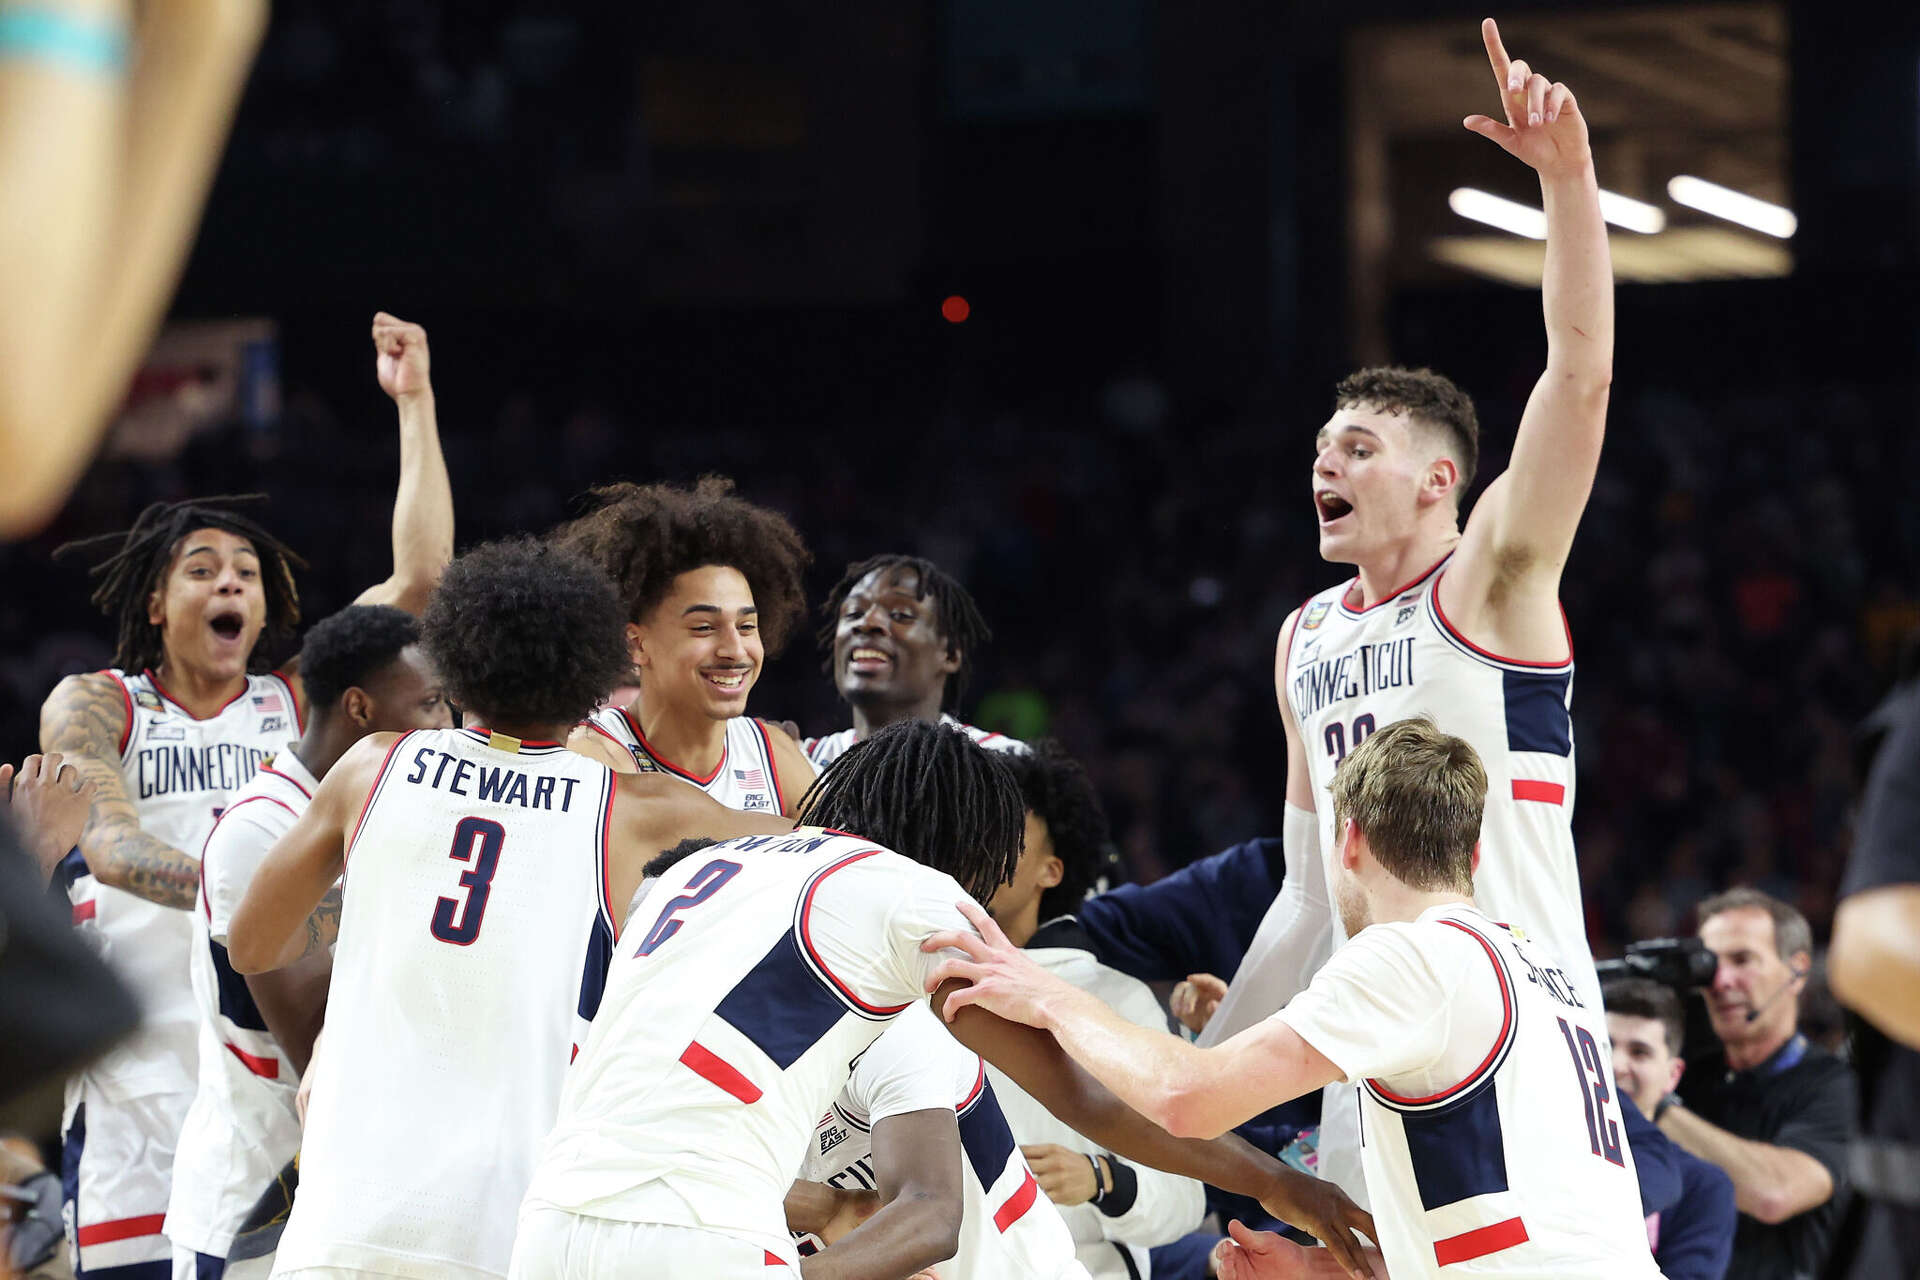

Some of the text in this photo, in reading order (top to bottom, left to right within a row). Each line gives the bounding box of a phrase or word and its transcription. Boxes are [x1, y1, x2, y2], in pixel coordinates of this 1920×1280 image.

[1294, 636, 1417, 721] CONNECTICUT
[407, 747, 581, 813] STEWART
[430, 816, 506, 946] 3
[632, 858, 744, 960] 2
[819, 1125, 838, 1142] BIG
[1556, 1015, 1626, 1169] 12
[820, 1128, 848, 1151] EAST
